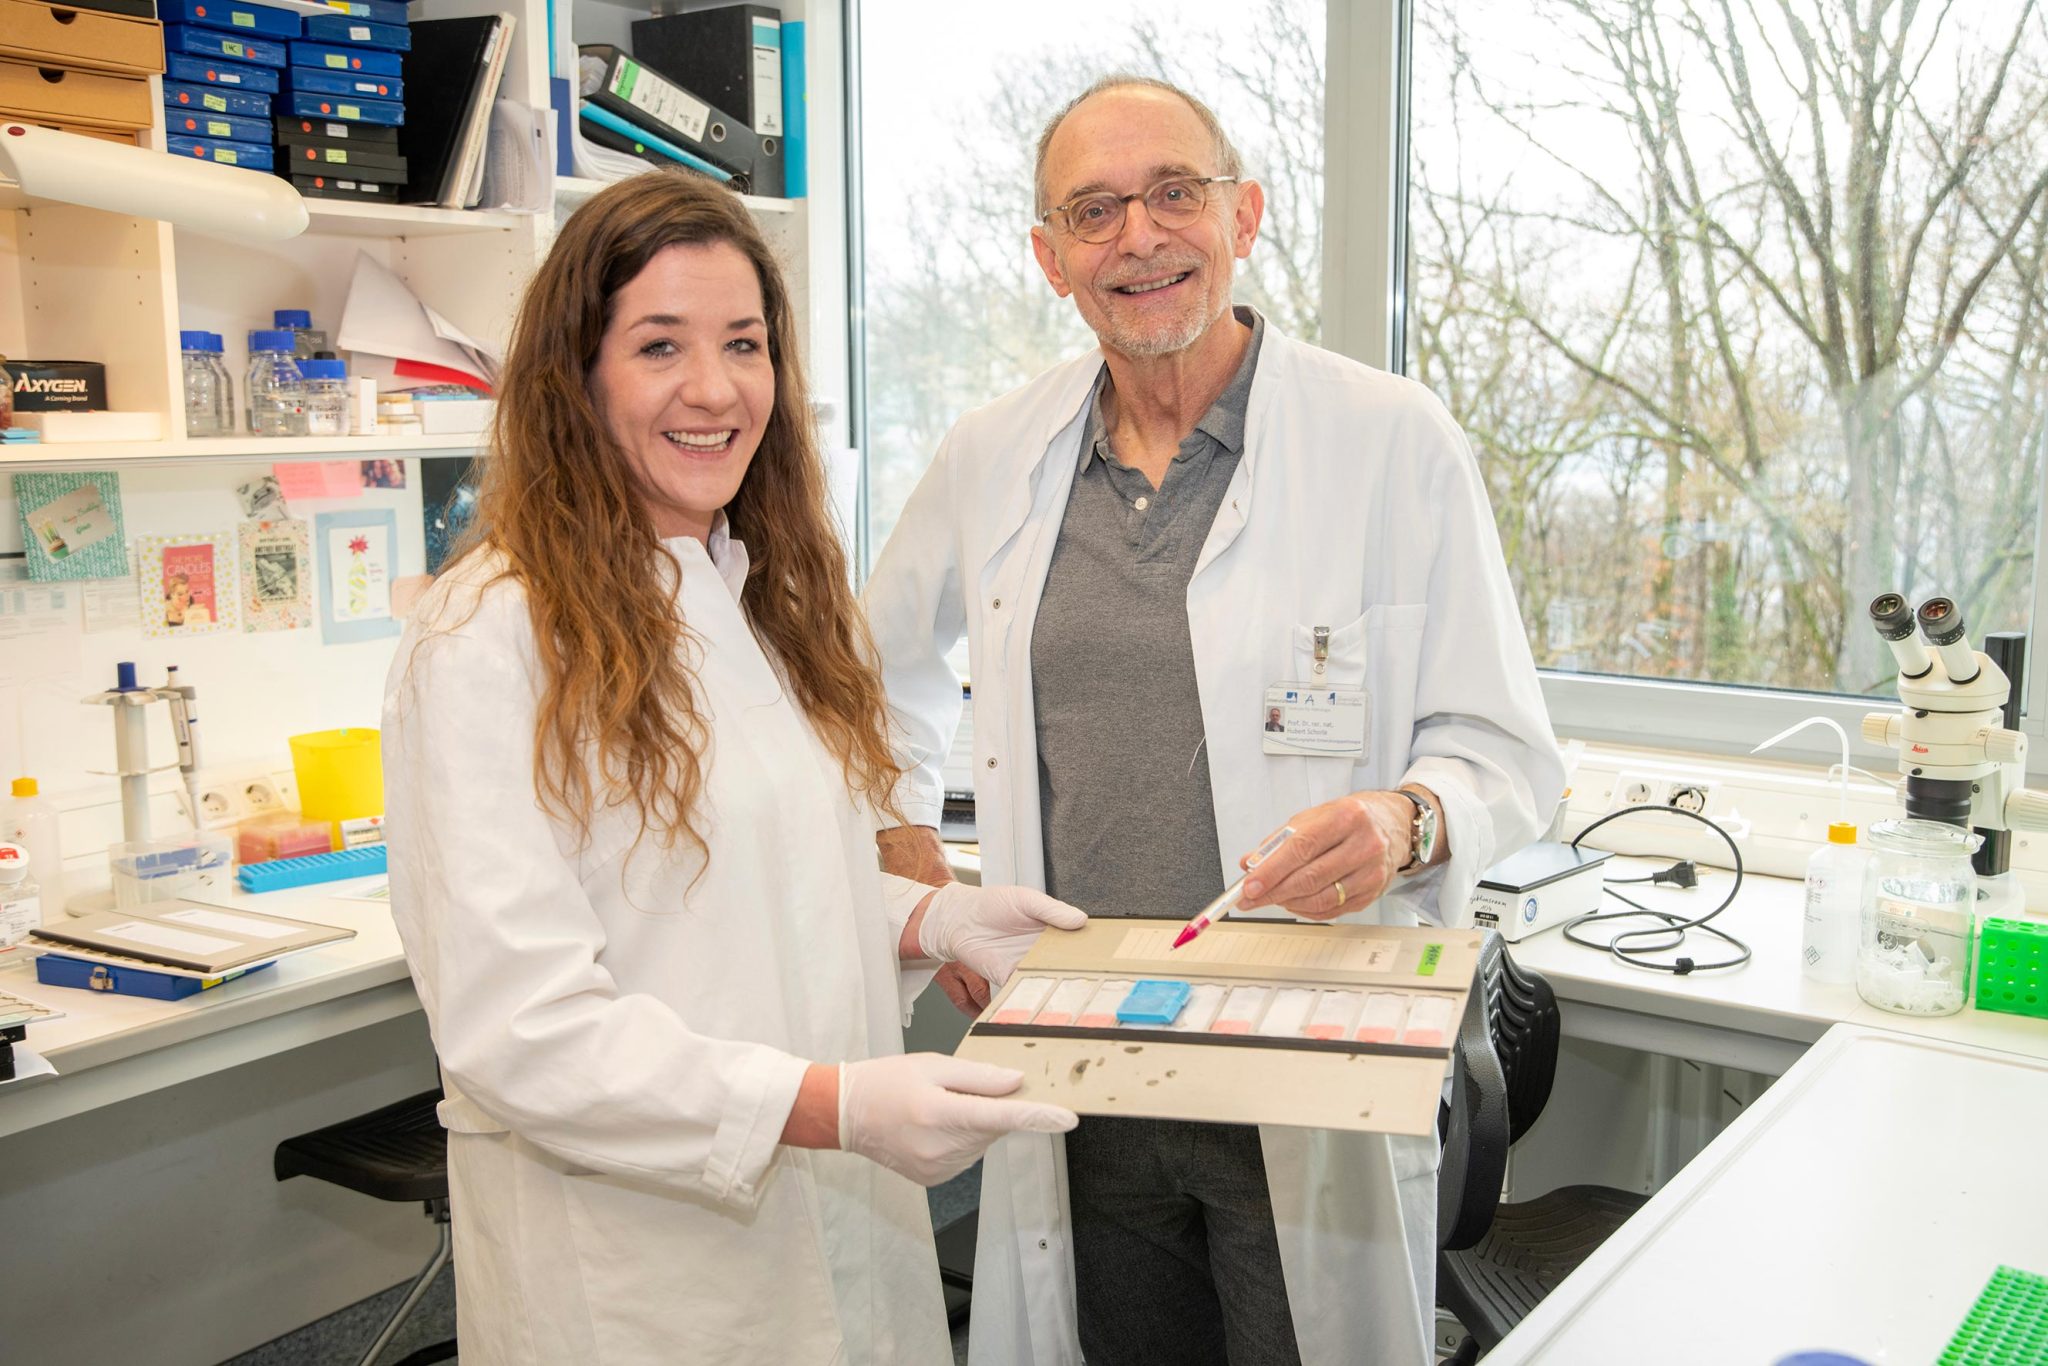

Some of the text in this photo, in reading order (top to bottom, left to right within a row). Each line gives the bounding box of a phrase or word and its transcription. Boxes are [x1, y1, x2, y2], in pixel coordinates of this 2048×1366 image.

[14, 372, 86, 392] AXYGEN
[167, 561, 212, 576] CANDLES
[1911, 744, 1929, 753] Leica
